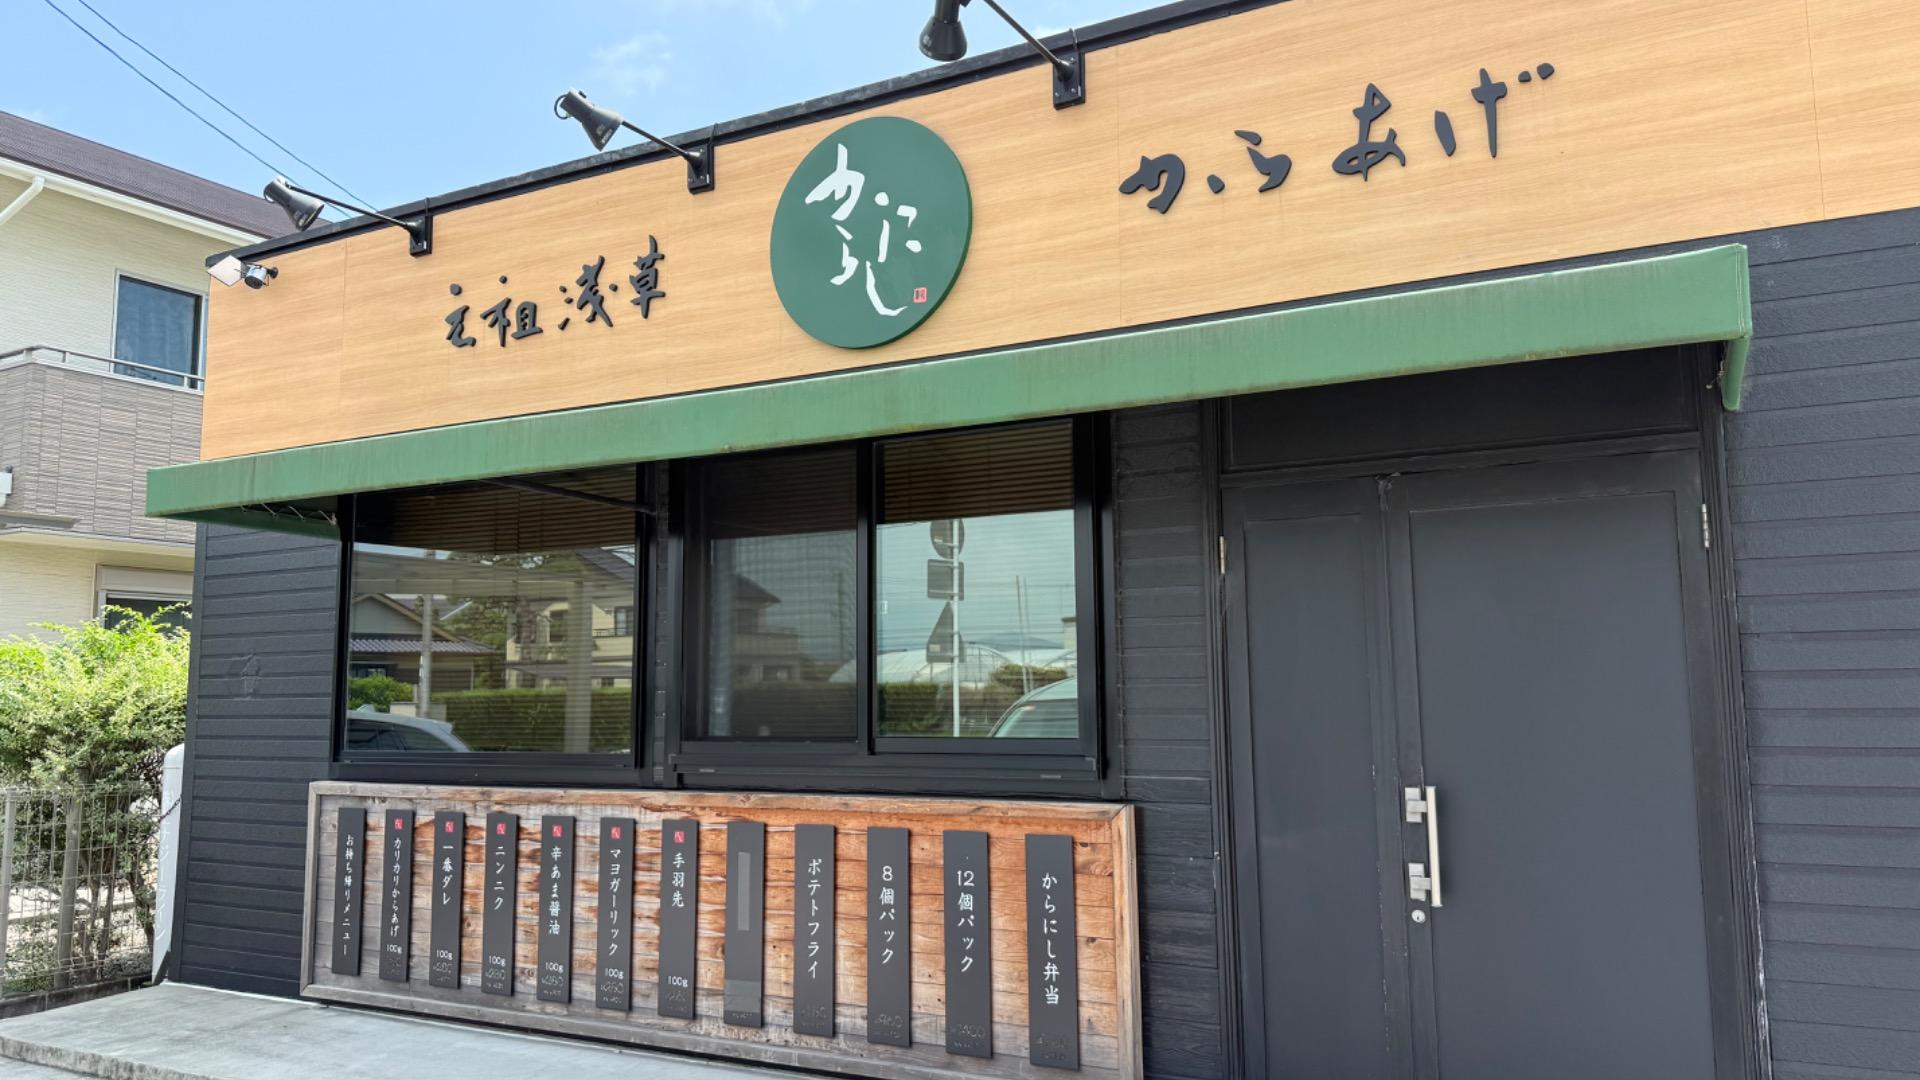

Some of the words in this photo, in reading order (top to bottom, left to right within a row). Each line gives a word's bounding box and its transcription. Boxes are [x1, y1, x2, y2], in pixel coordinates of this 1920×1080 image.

[1118, 62, 1556, 215] からあげ
[342, 834, 355, 956] お持ち帰りメニュー
[390, 837, 402, 937] カリカリからあげ
[493, 845, 507, 911] ニンニク
[548, 845, 563, 936] 辛あま醤油
[608, 848, 622, 956] マヨガーリック
[671, 851, 686, 909] 手羽先
[807, 857, 823, 979] ポテトフライ
[878, 865, 896, 965] 8個パック
[956, 869, 976, 973] 12個パック
[1041, 872, 1061, 1006] からにし弁当
